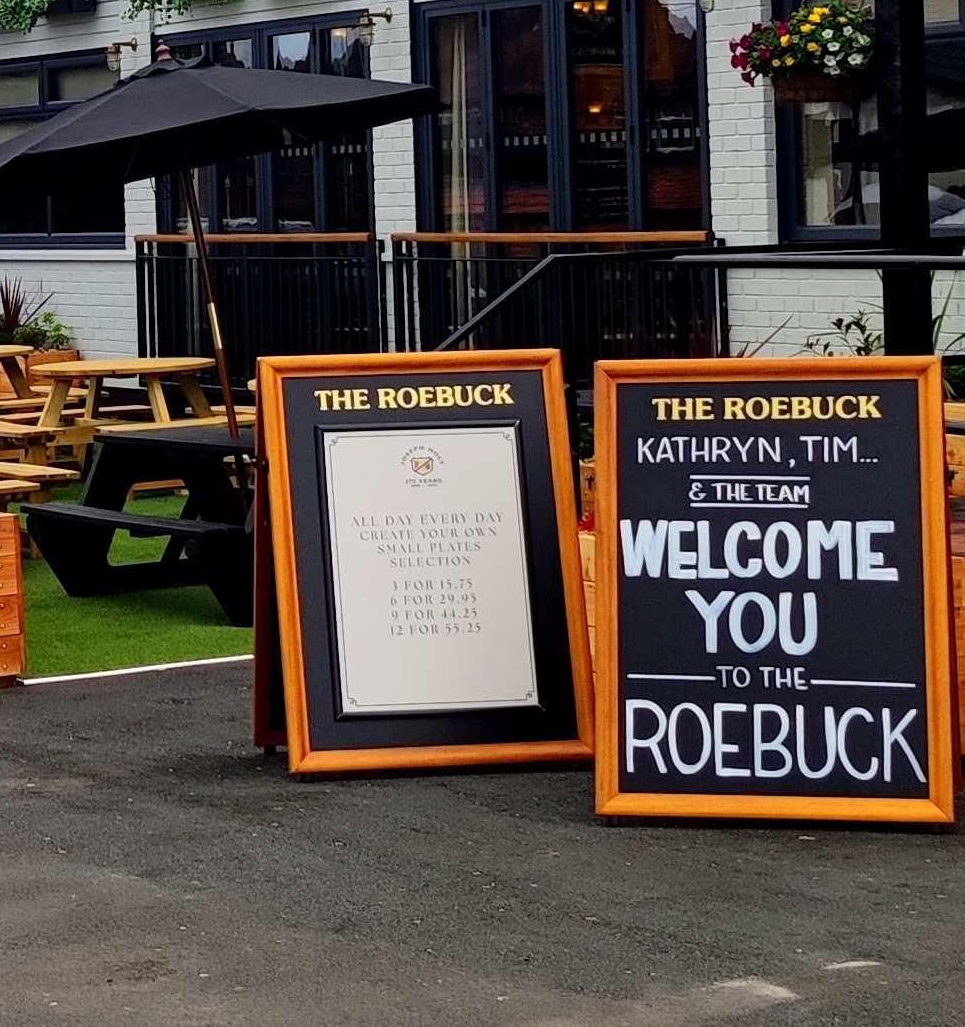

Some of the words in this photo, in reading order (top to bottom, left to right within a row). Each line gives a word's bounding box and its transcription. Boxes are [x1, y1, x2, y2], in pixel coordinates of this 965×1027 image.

[314, 388, 370, 411] THE
[378, 383, 514, 410] ROEBUCK
[652, 397, 715, 421] THE
[723, 395, 882, 421] ROEBUCK
[799, 435, 879, 465] TIM...
[688, 481, 705, 501] &
[710, 482, 753, 502] THE
[755, 483, 810, 504] TEAM
[351, 516, 379, 527] ALL
[385, 514, 413, 526] DAY
[420, 513, 468, 525] EVERY
[475, 511, 504, 524] DAY
[359, 529, 414, 541] CREATE
[420, 528, 458, 540] YOUR
[464, 526, 498, 538] OWN
[377, 543, 424, 555] SMALL
[430, 541, 482, 553] PLATES
[620, 519, 899, 582] WELCOME
[389, 555, 472, 568] SELECTION
[404, 580, 434, 591] FOR
[440, 578, 473, 590] 15.75
[403, 594, 434, 606] FOR
[439, 593, 477, 605] 29.95
[405, 609, 435, 621] FOR
[684, 589, 818, 656] YOU
[390, 624, 404, 636] 12
[409, 623, 439, 635] FOR
[444, 622, 482, 634] 55.25
[716, 665, 751, 688] TO
[759, 665, 809, 691] THE
[625, 699, 927, 783] ROEBUCK
